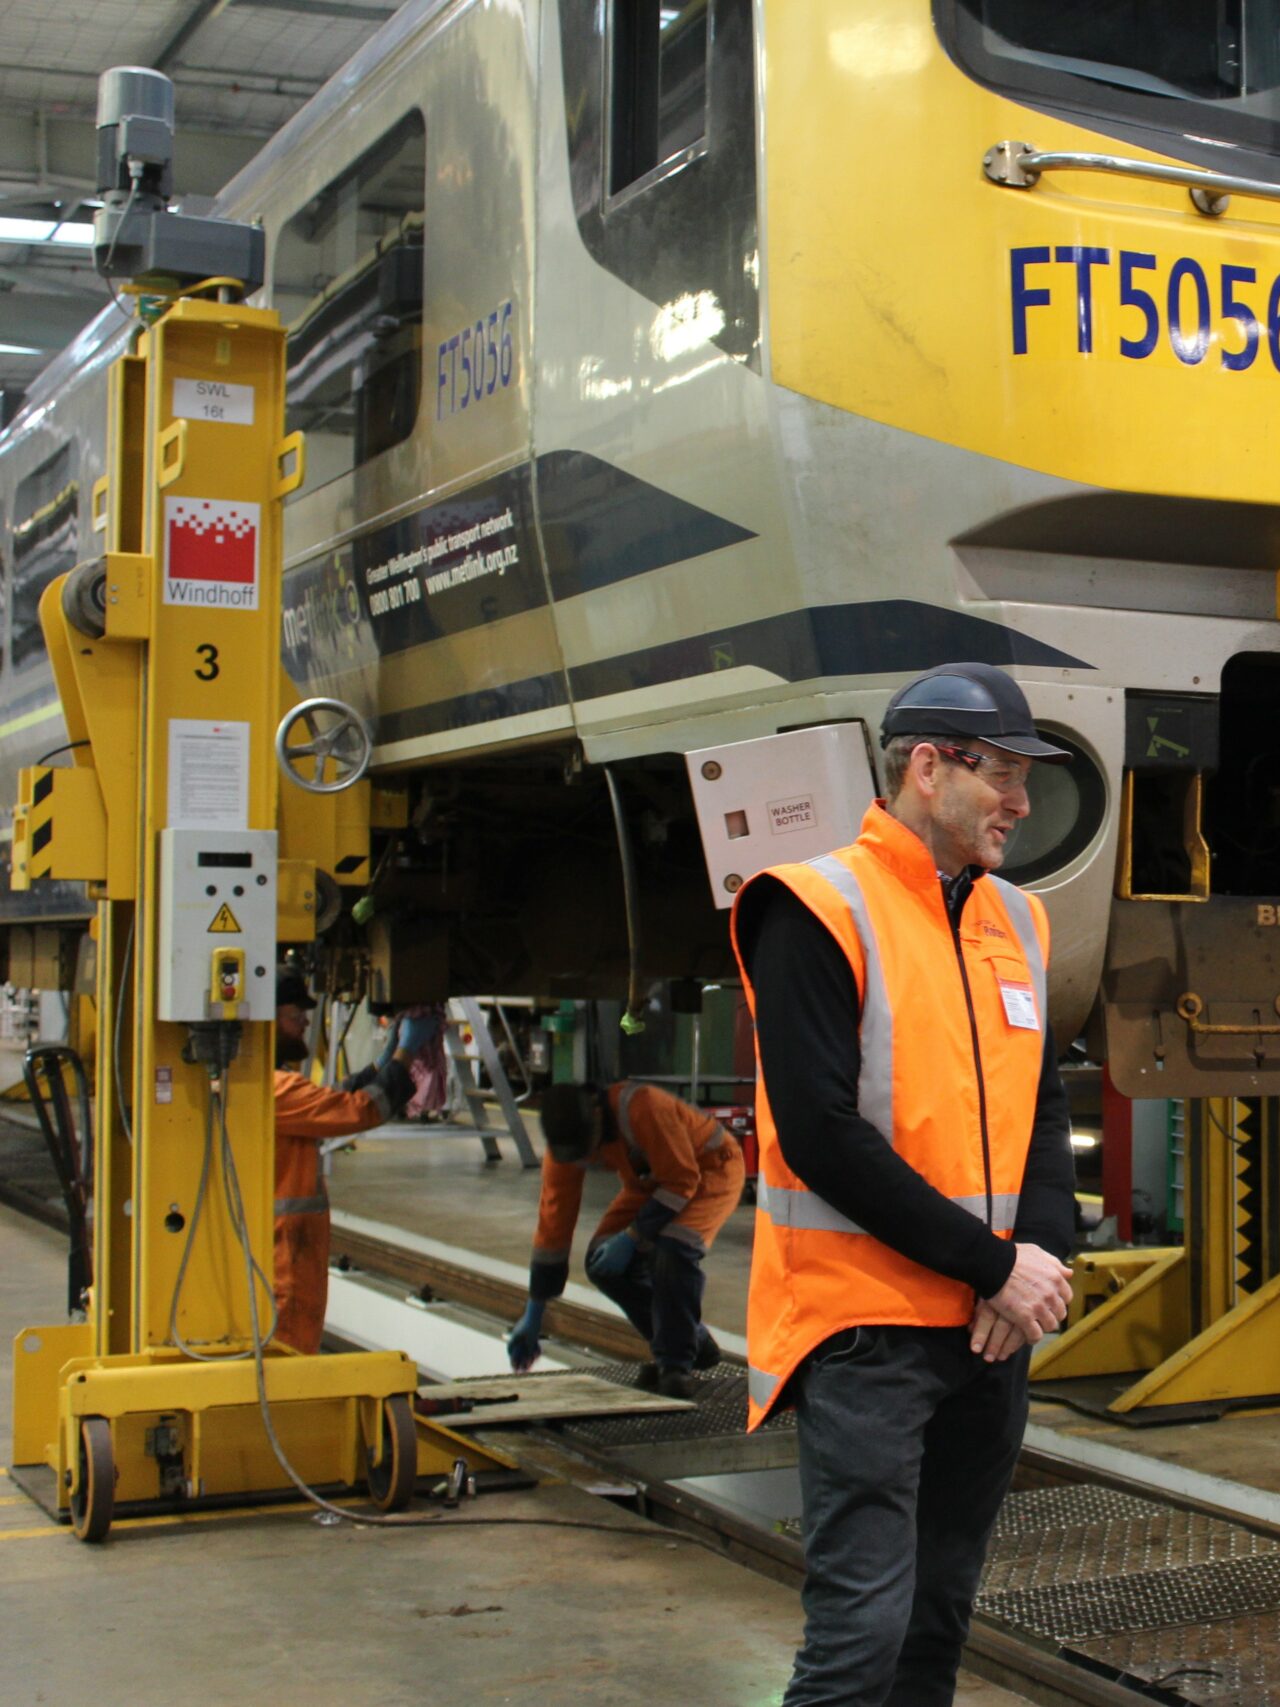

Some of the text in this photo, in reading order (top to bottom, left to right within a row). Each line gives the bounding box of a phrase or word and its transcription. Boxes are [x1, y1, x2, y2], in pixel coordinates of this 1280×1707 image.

[437, 302, 512, 421] FT5056
[196, 381, 231, 398] SWL
[203, 404, 225, 419] 16t
[480, 507, 514, 535] network
[168, 581, 255, 606] Windhoff
[403, 577, 422, 603] 700
[194, 643, 220, 682] 3
[771, 802, 811, 817] WASHER
[776, 812, 811, 826] BOTTLE
